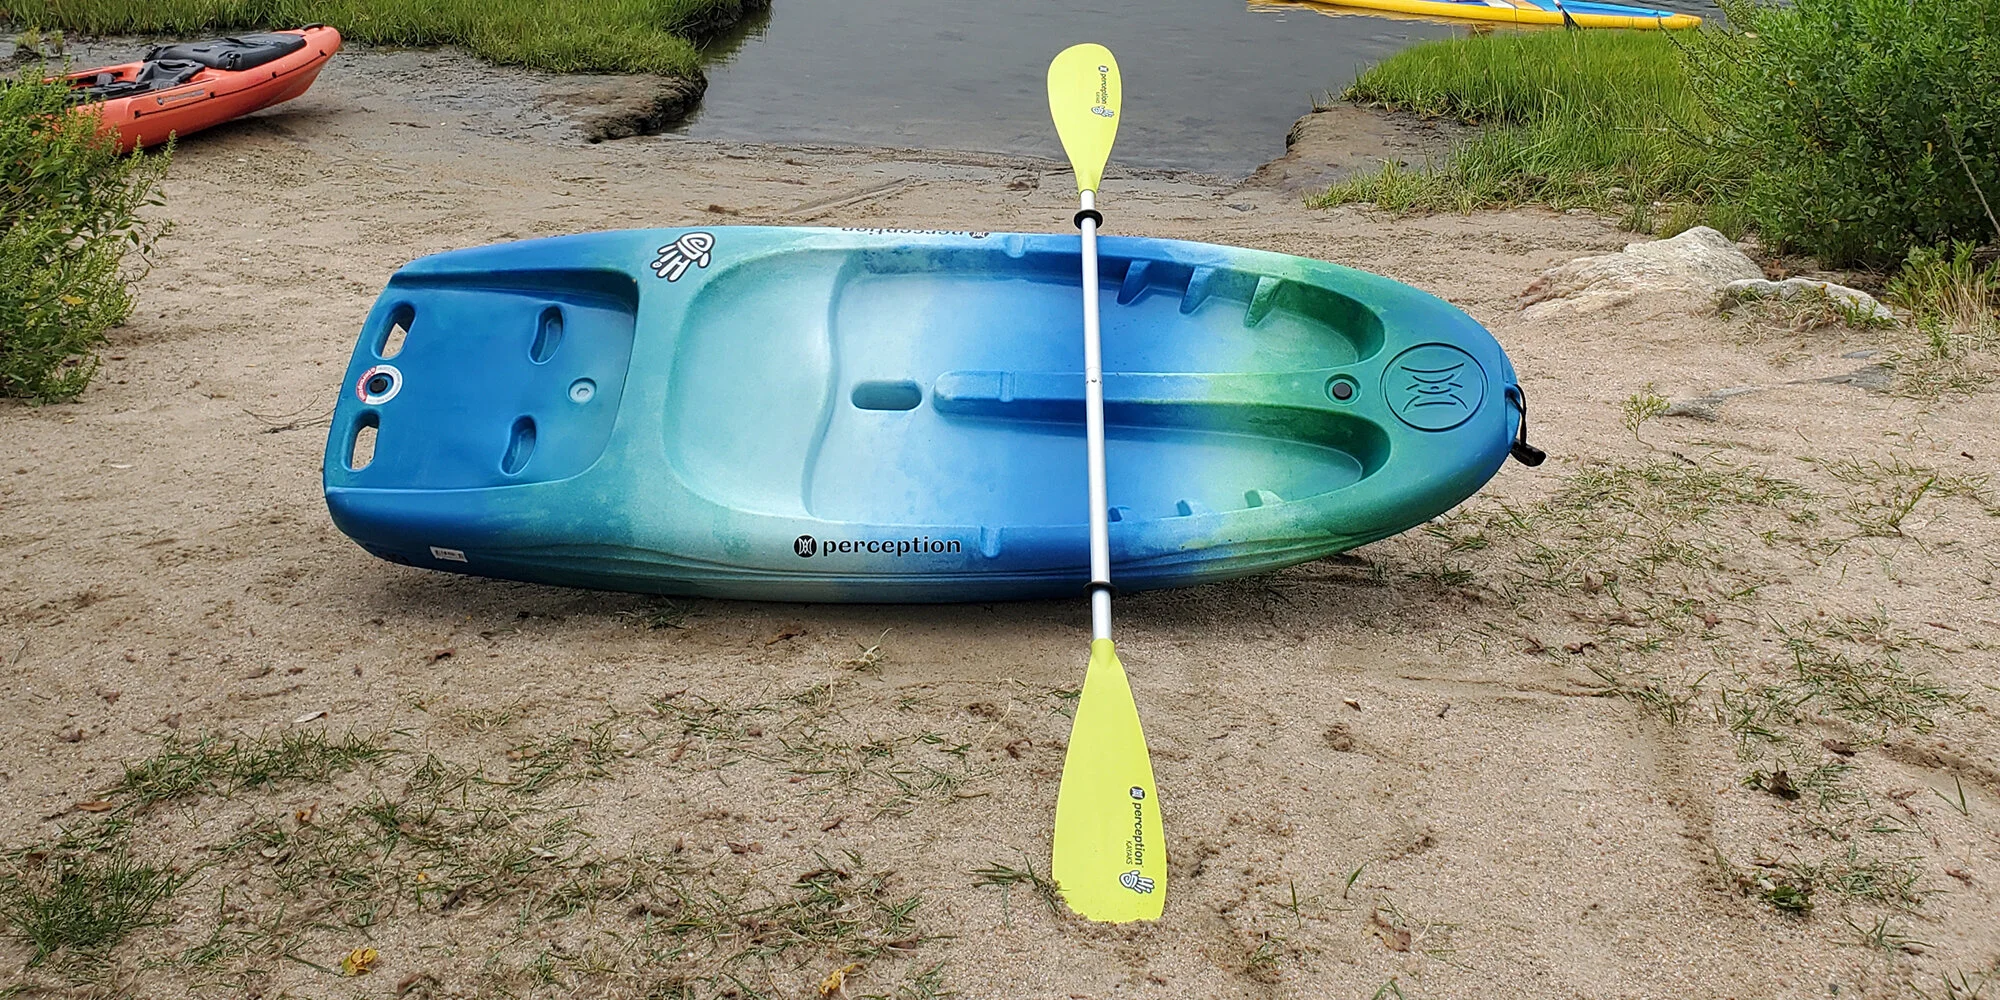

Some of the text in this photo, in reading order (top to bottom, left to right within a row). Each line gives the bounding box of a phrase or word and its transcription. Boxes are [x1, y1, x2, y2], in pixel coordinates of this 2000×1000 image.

[823, 536, 961, 557] perception
[1132, 802, 1146, 866] perception
[1125, 840, 1133, 865] KAYAKS
